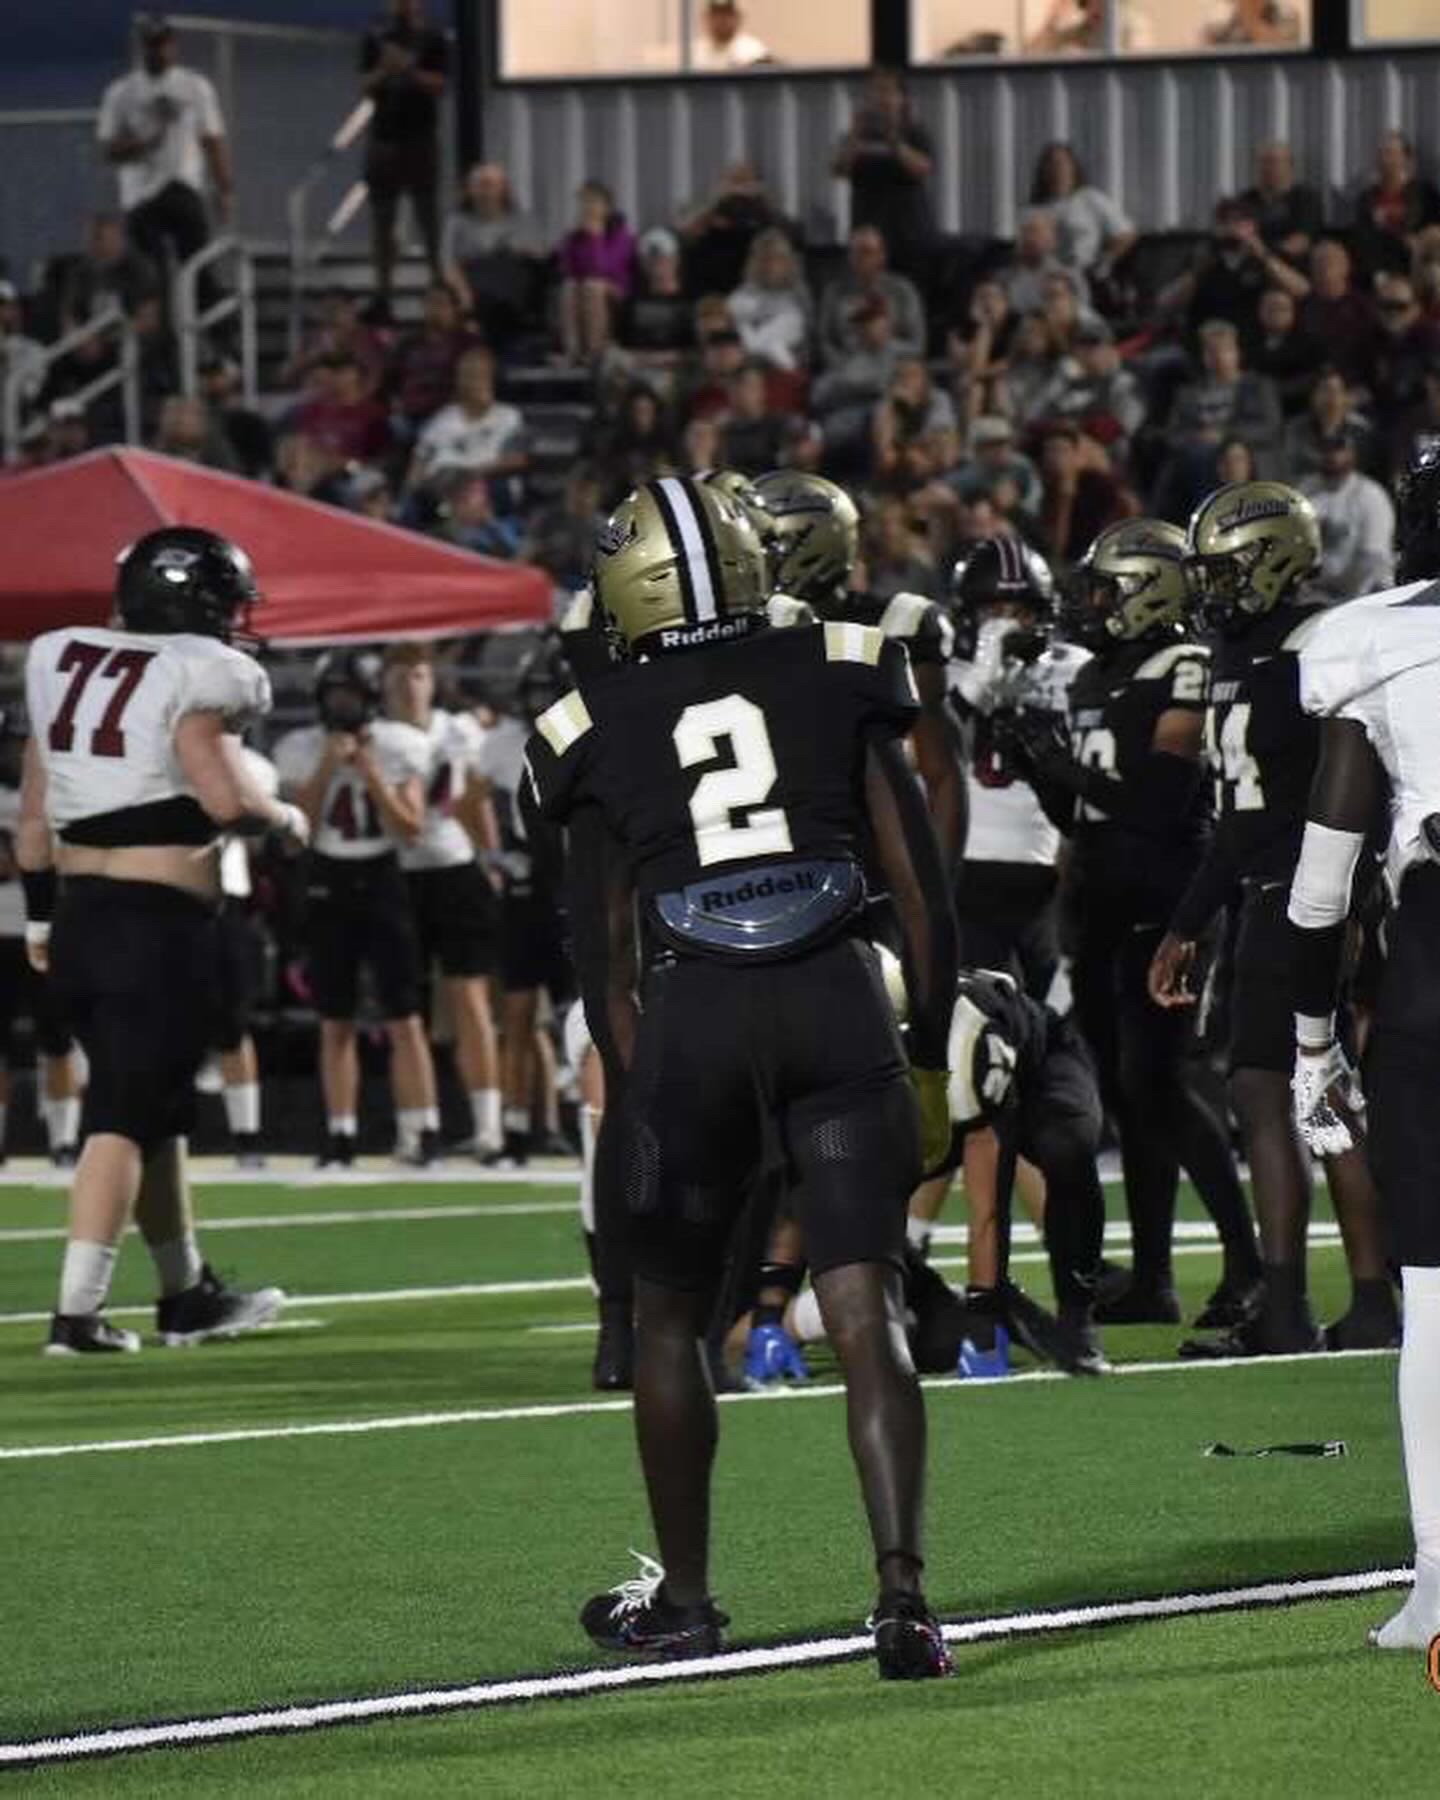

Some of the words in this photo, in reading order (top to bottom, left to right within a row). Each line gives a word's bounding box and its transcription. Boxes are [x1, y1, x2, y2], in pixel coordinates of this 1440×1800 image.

[661, 617, 748, 648] Riddell
[48, 639, 158, 758] 77
[672, 693, 794, 867] 2
[700, 871, 817, 912] Riddell
